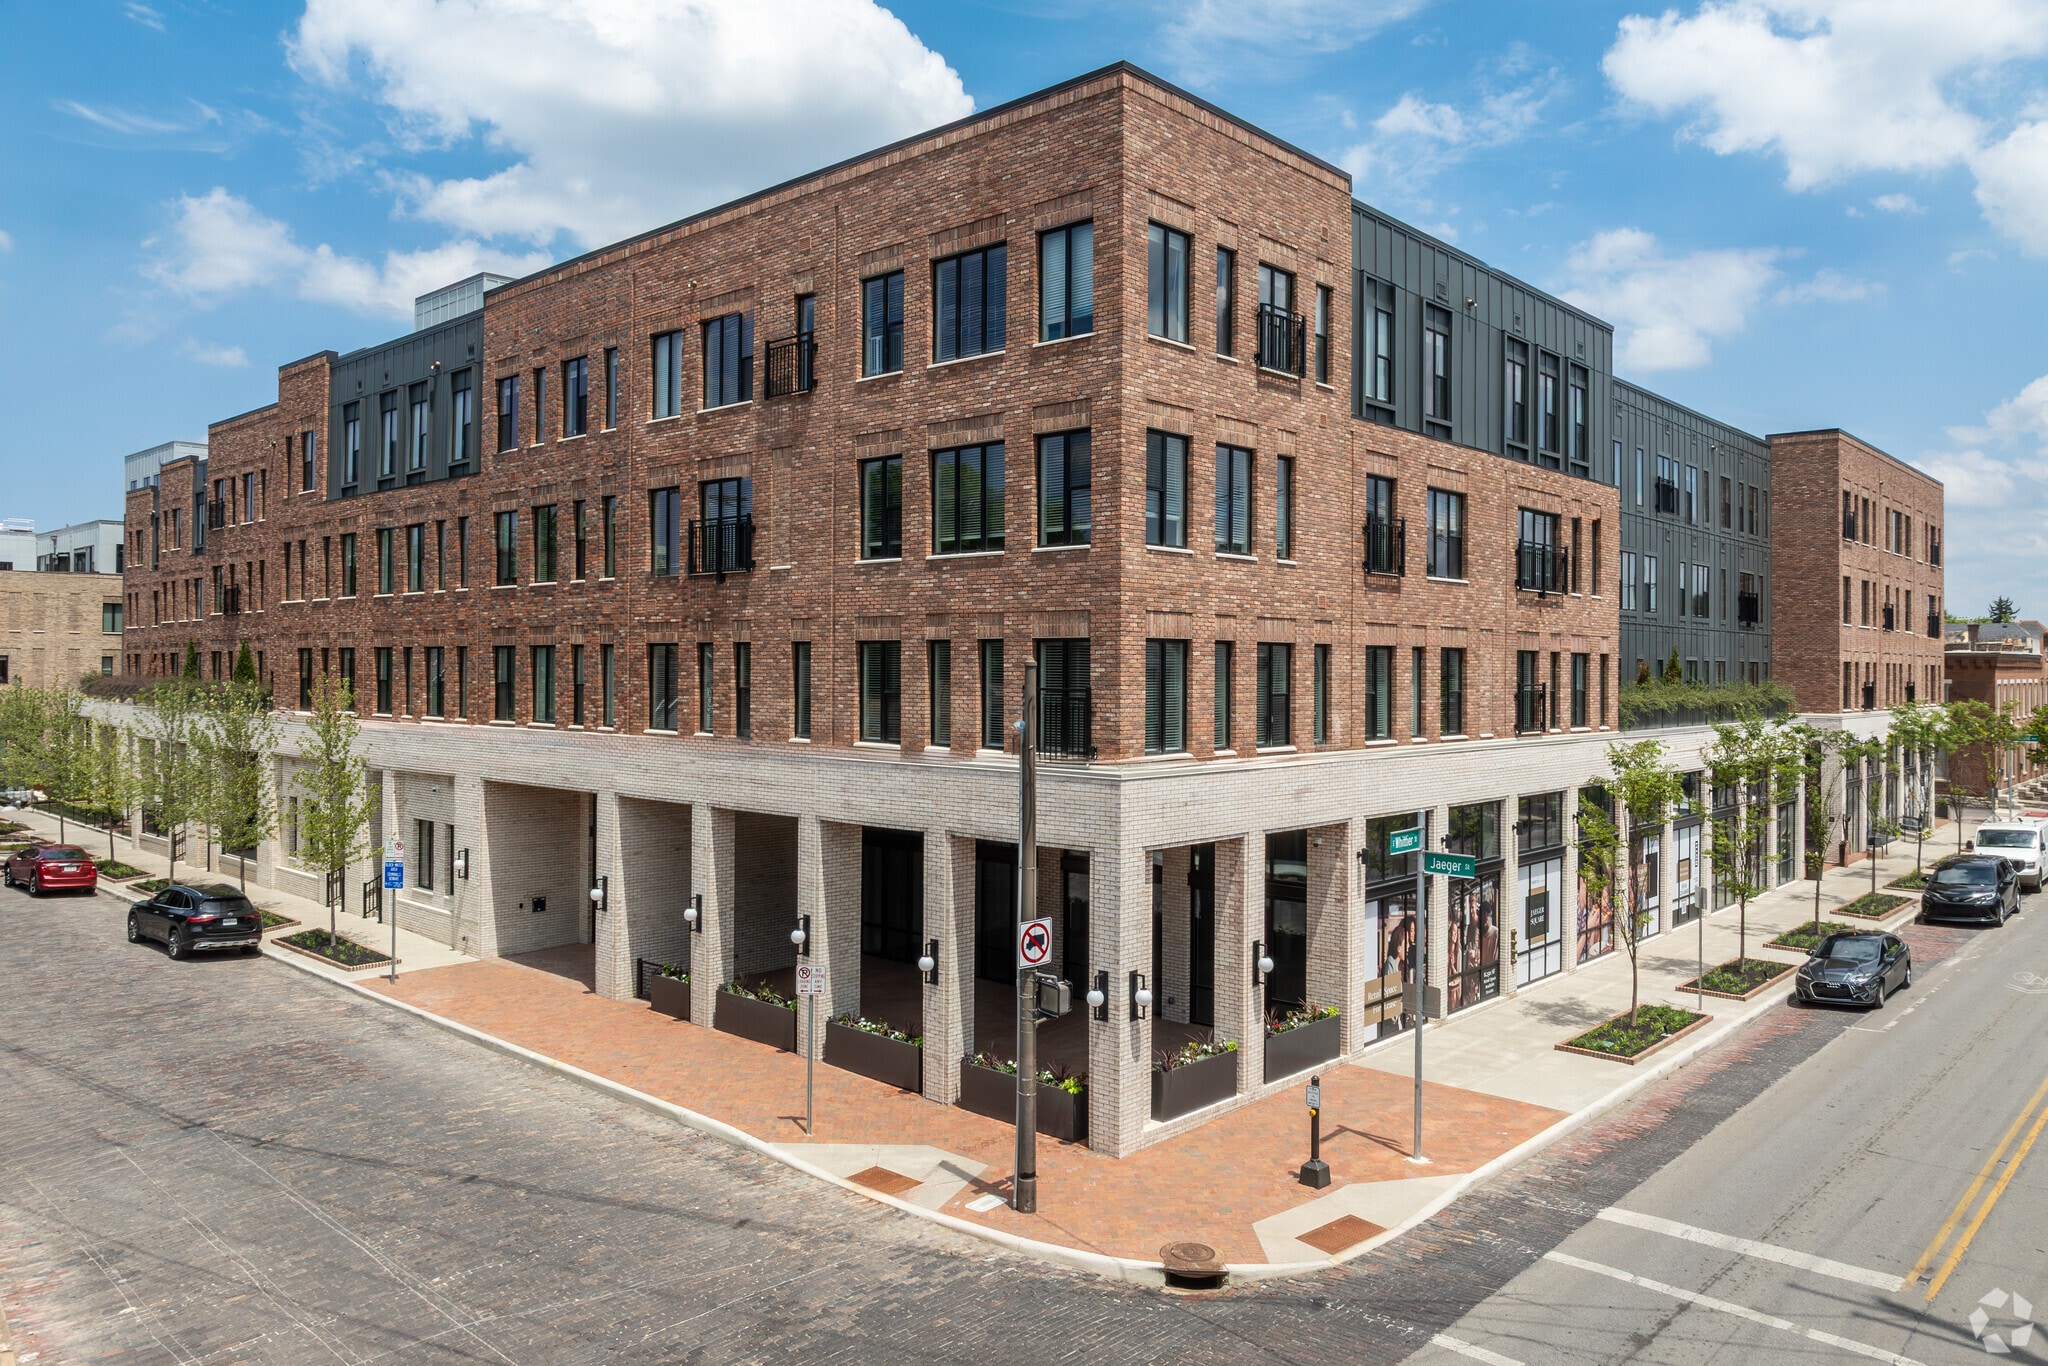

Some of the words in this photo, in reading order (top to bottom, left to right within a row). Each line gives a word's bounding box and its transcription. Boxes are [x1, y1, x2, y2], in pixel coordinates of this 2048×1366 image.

[1395, 835, 1413, 848] Whittier
[1430, 857, 1462, 874] Jaeger
[1530, 906, 1544, 918] JAEGER
[1530, 914, 1544, 926] SQUARE
[1368, 989, 1381, 1001] Retail
[1384, 985, 1398, 998] Space
[1373, 1005, 1381, 1014] For
